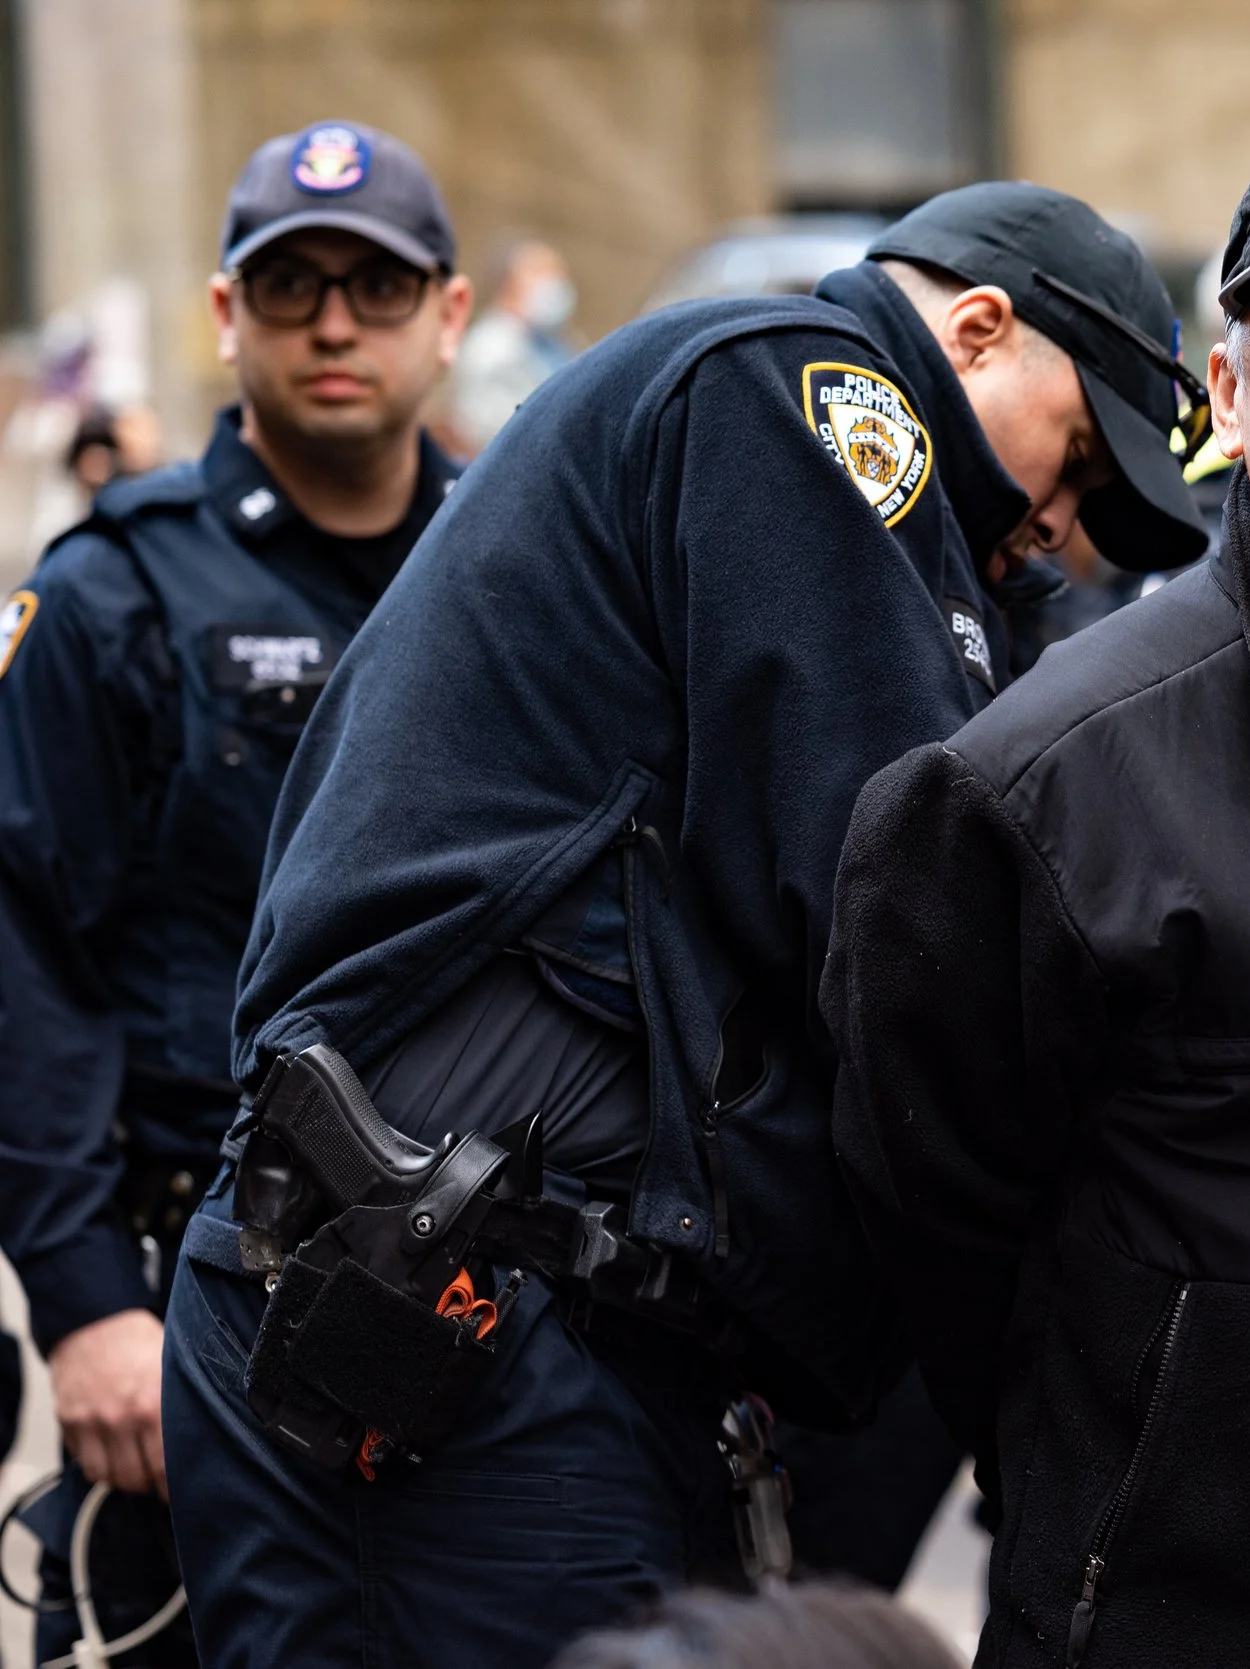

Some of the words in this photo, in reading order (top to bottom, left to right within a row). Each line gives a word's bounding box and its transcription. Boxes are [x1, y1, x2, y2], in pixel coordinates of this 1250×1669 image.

[820, 386, 920, 439] DEPARTMENT
[844, 373, 901, 408] POLICE
[876, 487, 905, 518] NEW
[901, 450, 926, 491] YORK
